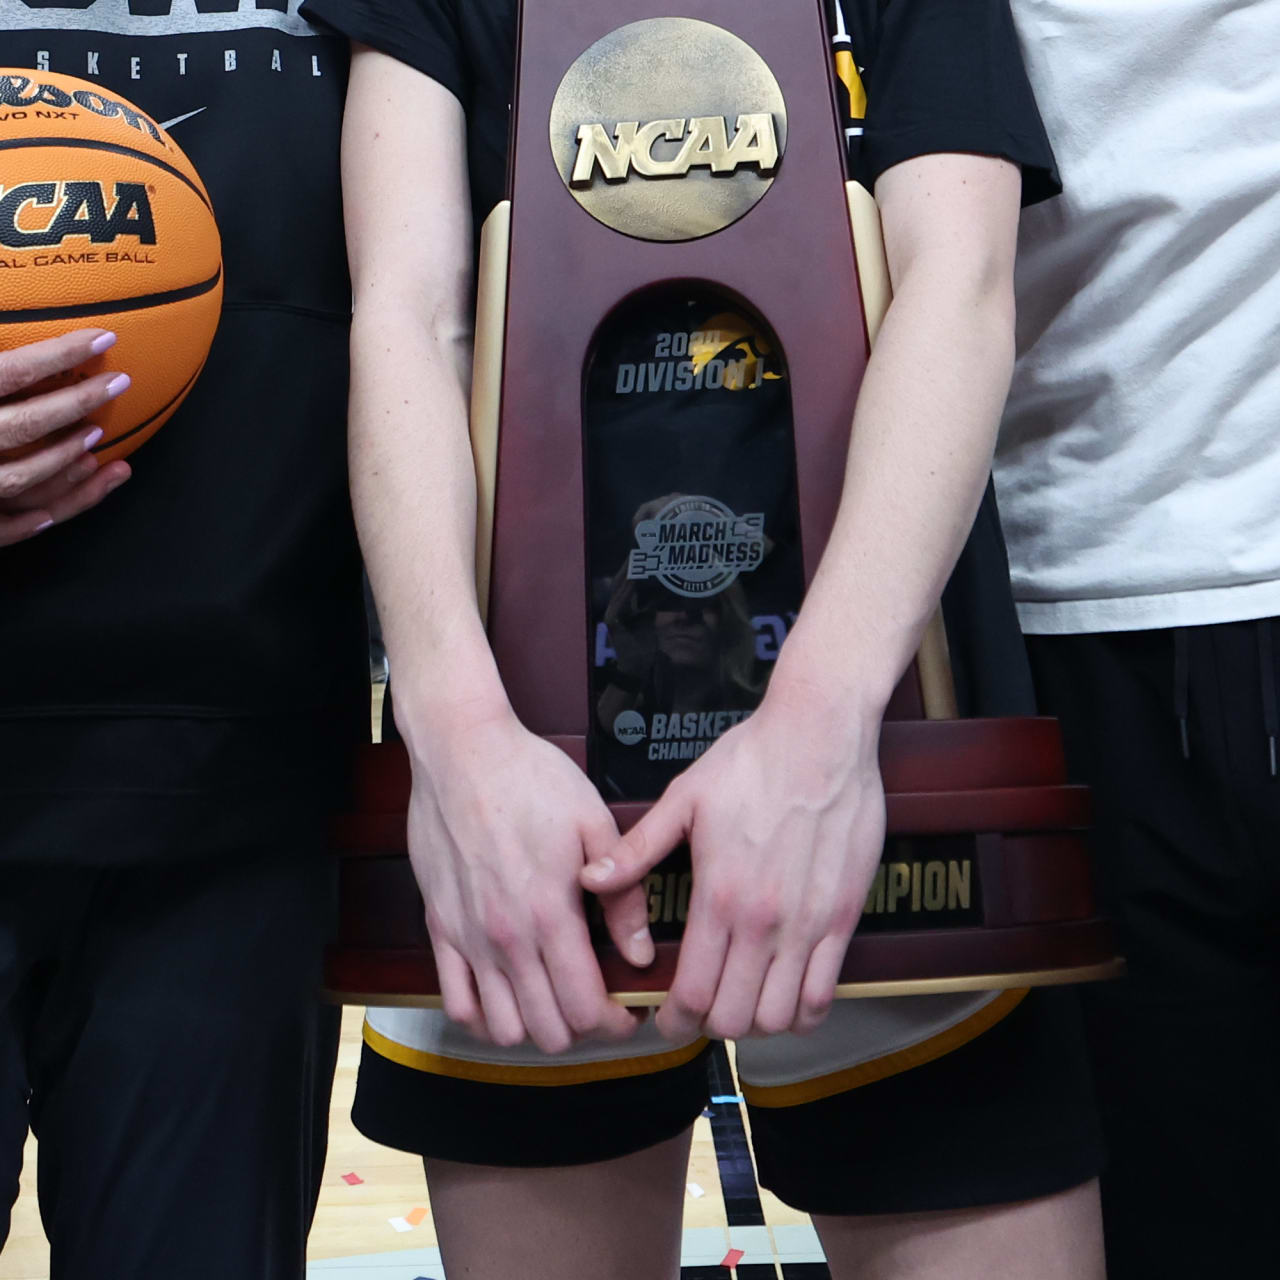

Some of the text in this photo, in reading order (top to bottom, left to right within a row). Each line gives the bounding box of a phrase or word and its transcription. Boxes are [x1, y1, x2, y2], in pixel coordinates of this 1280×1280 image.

[34, 109, 80, 122] NXT
[569, 111, 781, 190] NCAA
[33, 252, 100, 266] GAME
[105, 250, 156, 265] BALL
[616, 357, 747, 395] DIVISION
[660, 520, 728, 544] MARCH
[667, 541, 761, 566] MADNESS
